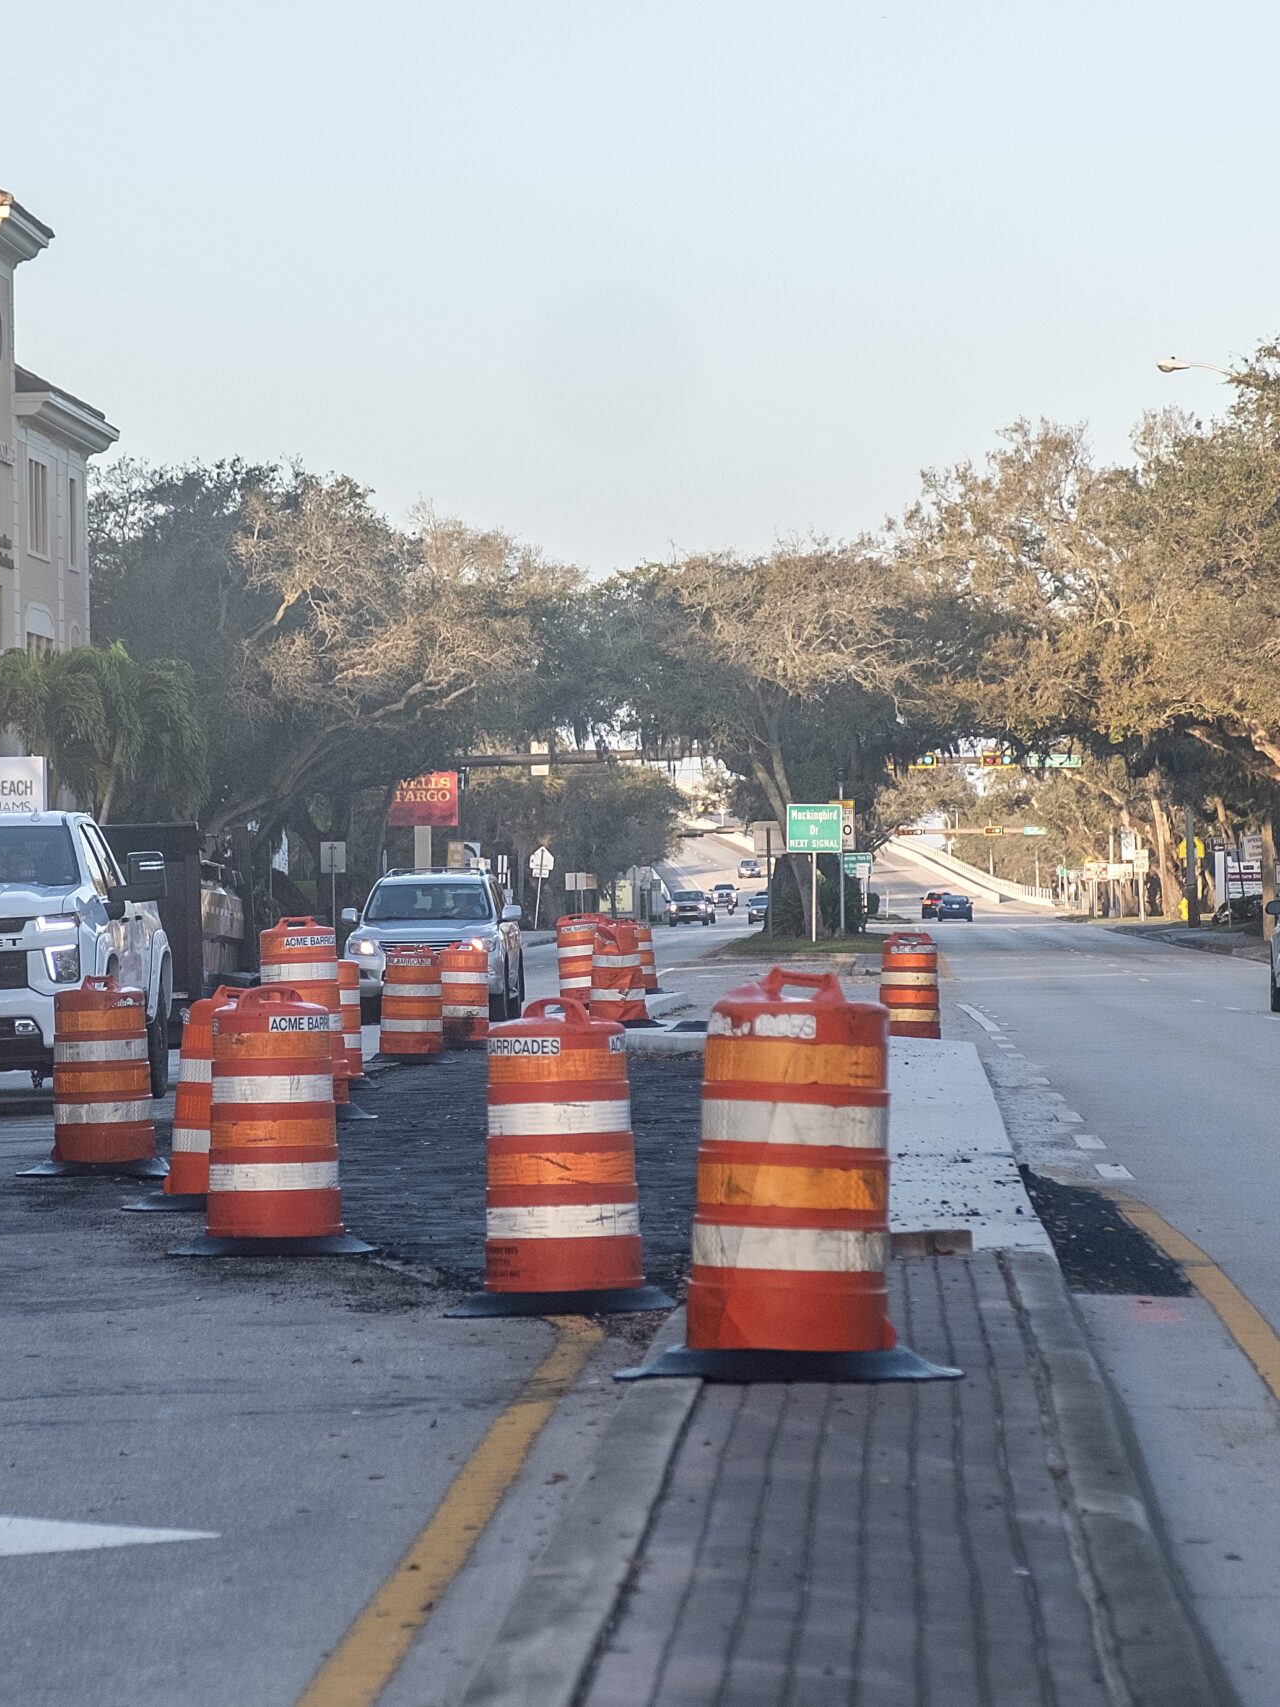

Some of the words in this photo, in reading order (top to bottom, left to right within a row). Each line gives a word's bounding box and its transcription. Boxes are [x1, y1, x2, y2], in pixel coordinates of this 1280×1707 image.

[395, 790, 450, 802] FARGO
[791, 809, 838, 823] Mockingbird
[809, 824, 819, 835] Dr
[790, 839, 808, 848] NEXT
[812, 839, 839, 848] SIGNAL
[285, 937, 308, 947] ACME
[270, 1018, 304, 1032] ACME
